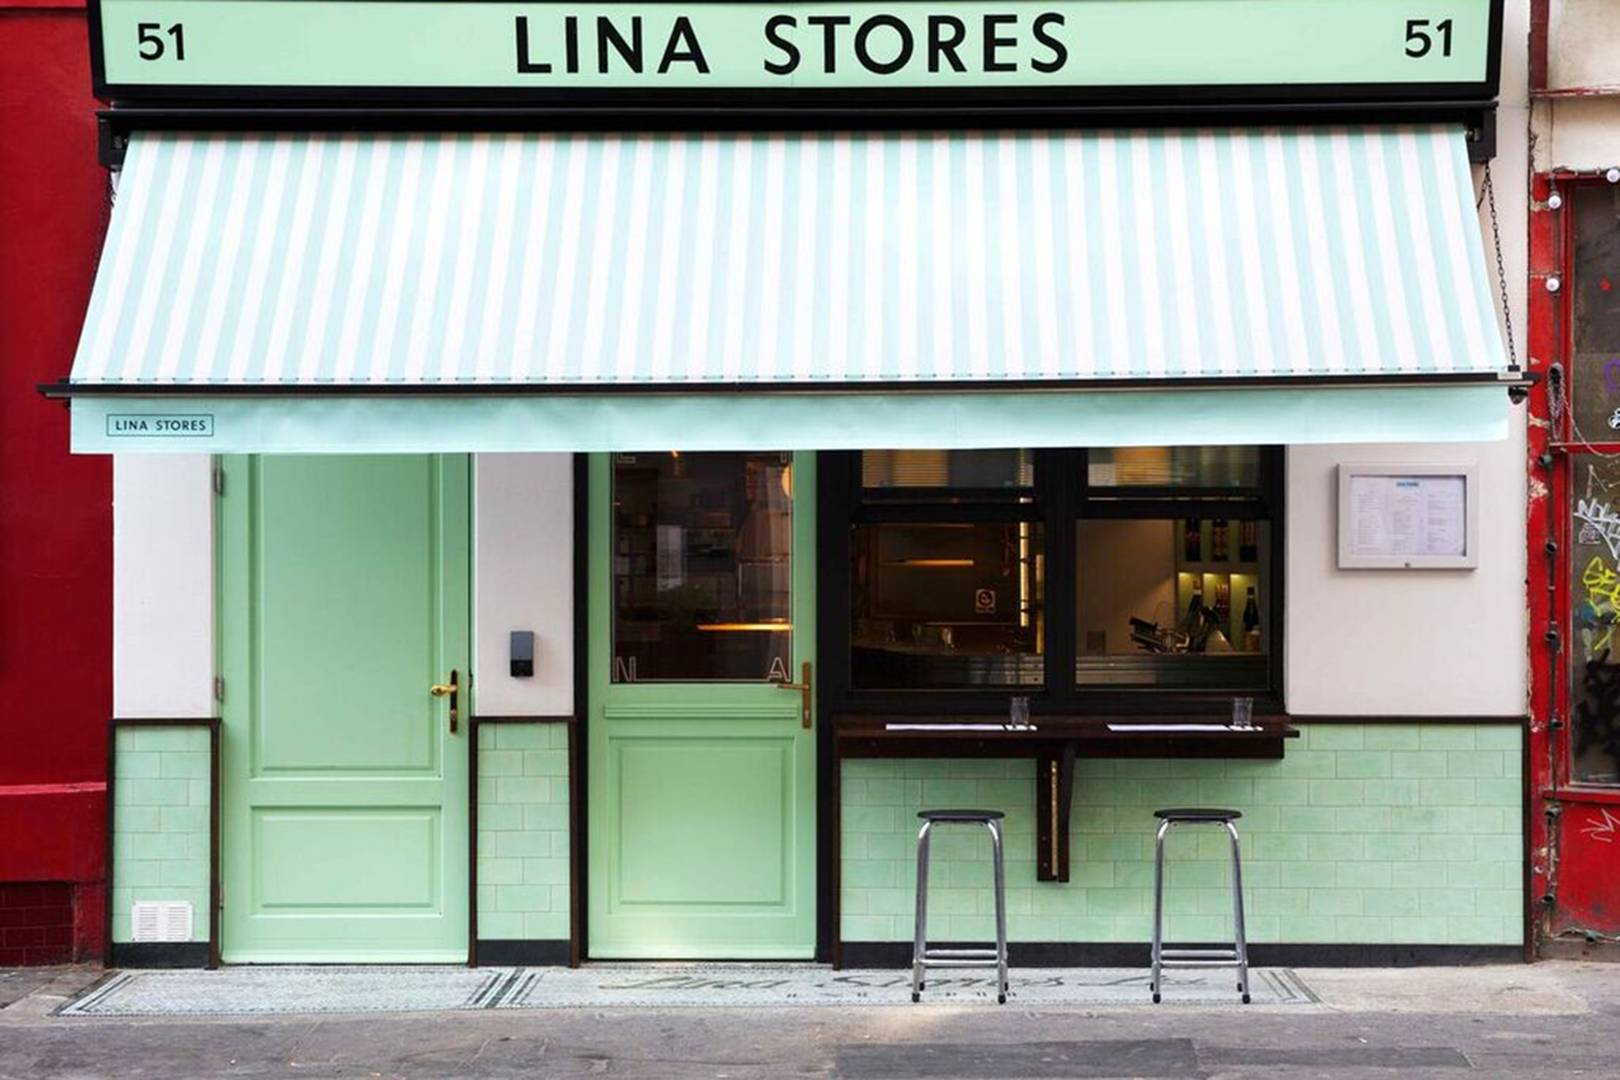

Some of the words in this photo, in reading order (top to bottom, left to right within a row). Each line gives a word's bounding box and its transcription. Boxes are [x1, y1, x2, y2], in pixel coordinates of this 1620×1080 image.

[137, 22, 185, 61] 51
[515, 15, 711, 74] LINA
[763, 12, 1068, 75] STORES
[1405, 18, 1453, 59] 51
[115, 419, 148, 431] LINA
[155, 419, 206, 431] STORES
